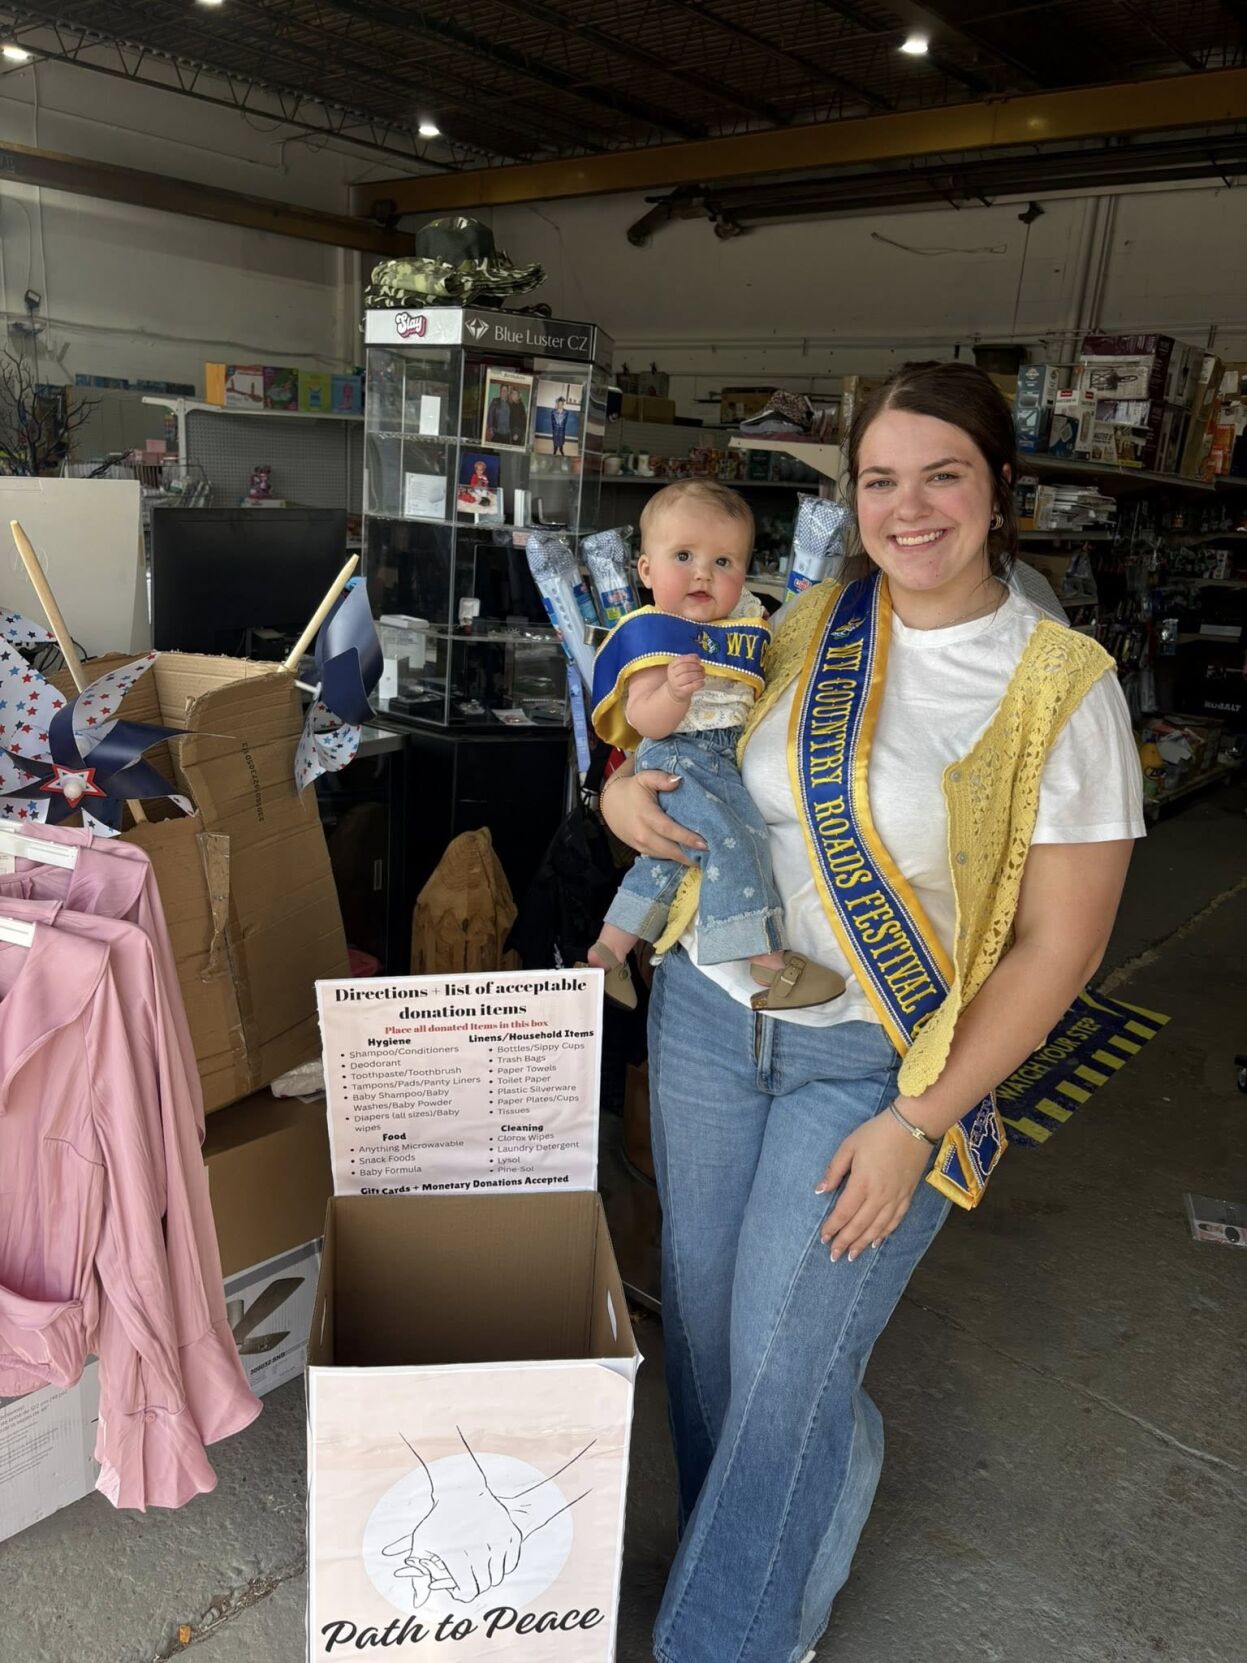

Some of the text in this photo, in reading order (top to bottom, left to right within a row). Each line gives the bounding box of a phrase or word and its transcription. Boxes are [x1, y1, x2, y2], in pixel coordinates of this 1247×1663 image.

[396, 312, 426, 337] Slay
[495, 325, 588, 352] Blue Luster CZ
[726, 632, 759, 660] WV
[822, 637, 864, 672] WV
[809, 677, 857, 788] COUNTRY
[813, 795, 873, 889] ROADS
[844, 889, 938, 1014] FESTIVAL
[335, 978, 587, 1002] Directions + list of acceptable
[399, 1004, 527, 1020] donation items
[385, 1026, 411, 1034] Place
[414, 1025, 426, 1033] all
[428, 1023, 468, 1032] donated
[510, 1020, 530, 1028] this
[468, 1029, 594, 1042] Linens/Household Items
[368, 1038, 411, 1047] Hygiene
[497, 1042, 585, 1054] Bottles/Sippy Cups
[349, 1046, 459, 1059] Shampoo/Conditioners
[997, 1017, 1102, 1100] WATCH YOUR STEP
[350, 1060, 401, 1070] Deodorant
[497, 1055, 546, 1064] Trash Bags
[351, 1067, 462, 1080] Toothpaste/Toothbrush
[497, 1064, 556, 1076] Paper Towels
[352, 1076, 481, 1091] Tampons/Pads/Panty Liners
[498, 1075, 550, 1084] Toilet Paper
[352, 1089, 449, 1102] Baby Shampoo/Baby
[498, 1085, 576, 1095] Plastic Silverware
[353, 1099, 452, 1112] Washes/Baby Powder
[498, 1094, 579, 1106] Paper Plates/Cups
[354, 1109, 460, 1124] Diapers (all sizes)/Baby
[498, 1107, 530, 1115] Tissues
[501, 1124, 544, 1132] Cleaning
[382, 1133, 406, 1141] Food
[497, 1134, 525, 1142] Clorox
[359, 1140, 464, 1154] Anything Microwavable
[498, 1142, 579, 1154] Laundry Detergent
[359, 1154, 416, 1165] Snack Foods
[498, 1157, 520, 1165] Lysol
[360, 1165, 422, 1177] Baby Formula
[360, 1187, 379, 1195] Gift
[382, 1185, 410, 1195] Cards
[422, 1181, 471, 1191] Monetary
[473, 1178, 522, 1188] Donations
[524, 1175, 569, 1184] Accepted
[321, 1606, 605, 1653] Path to Peace
